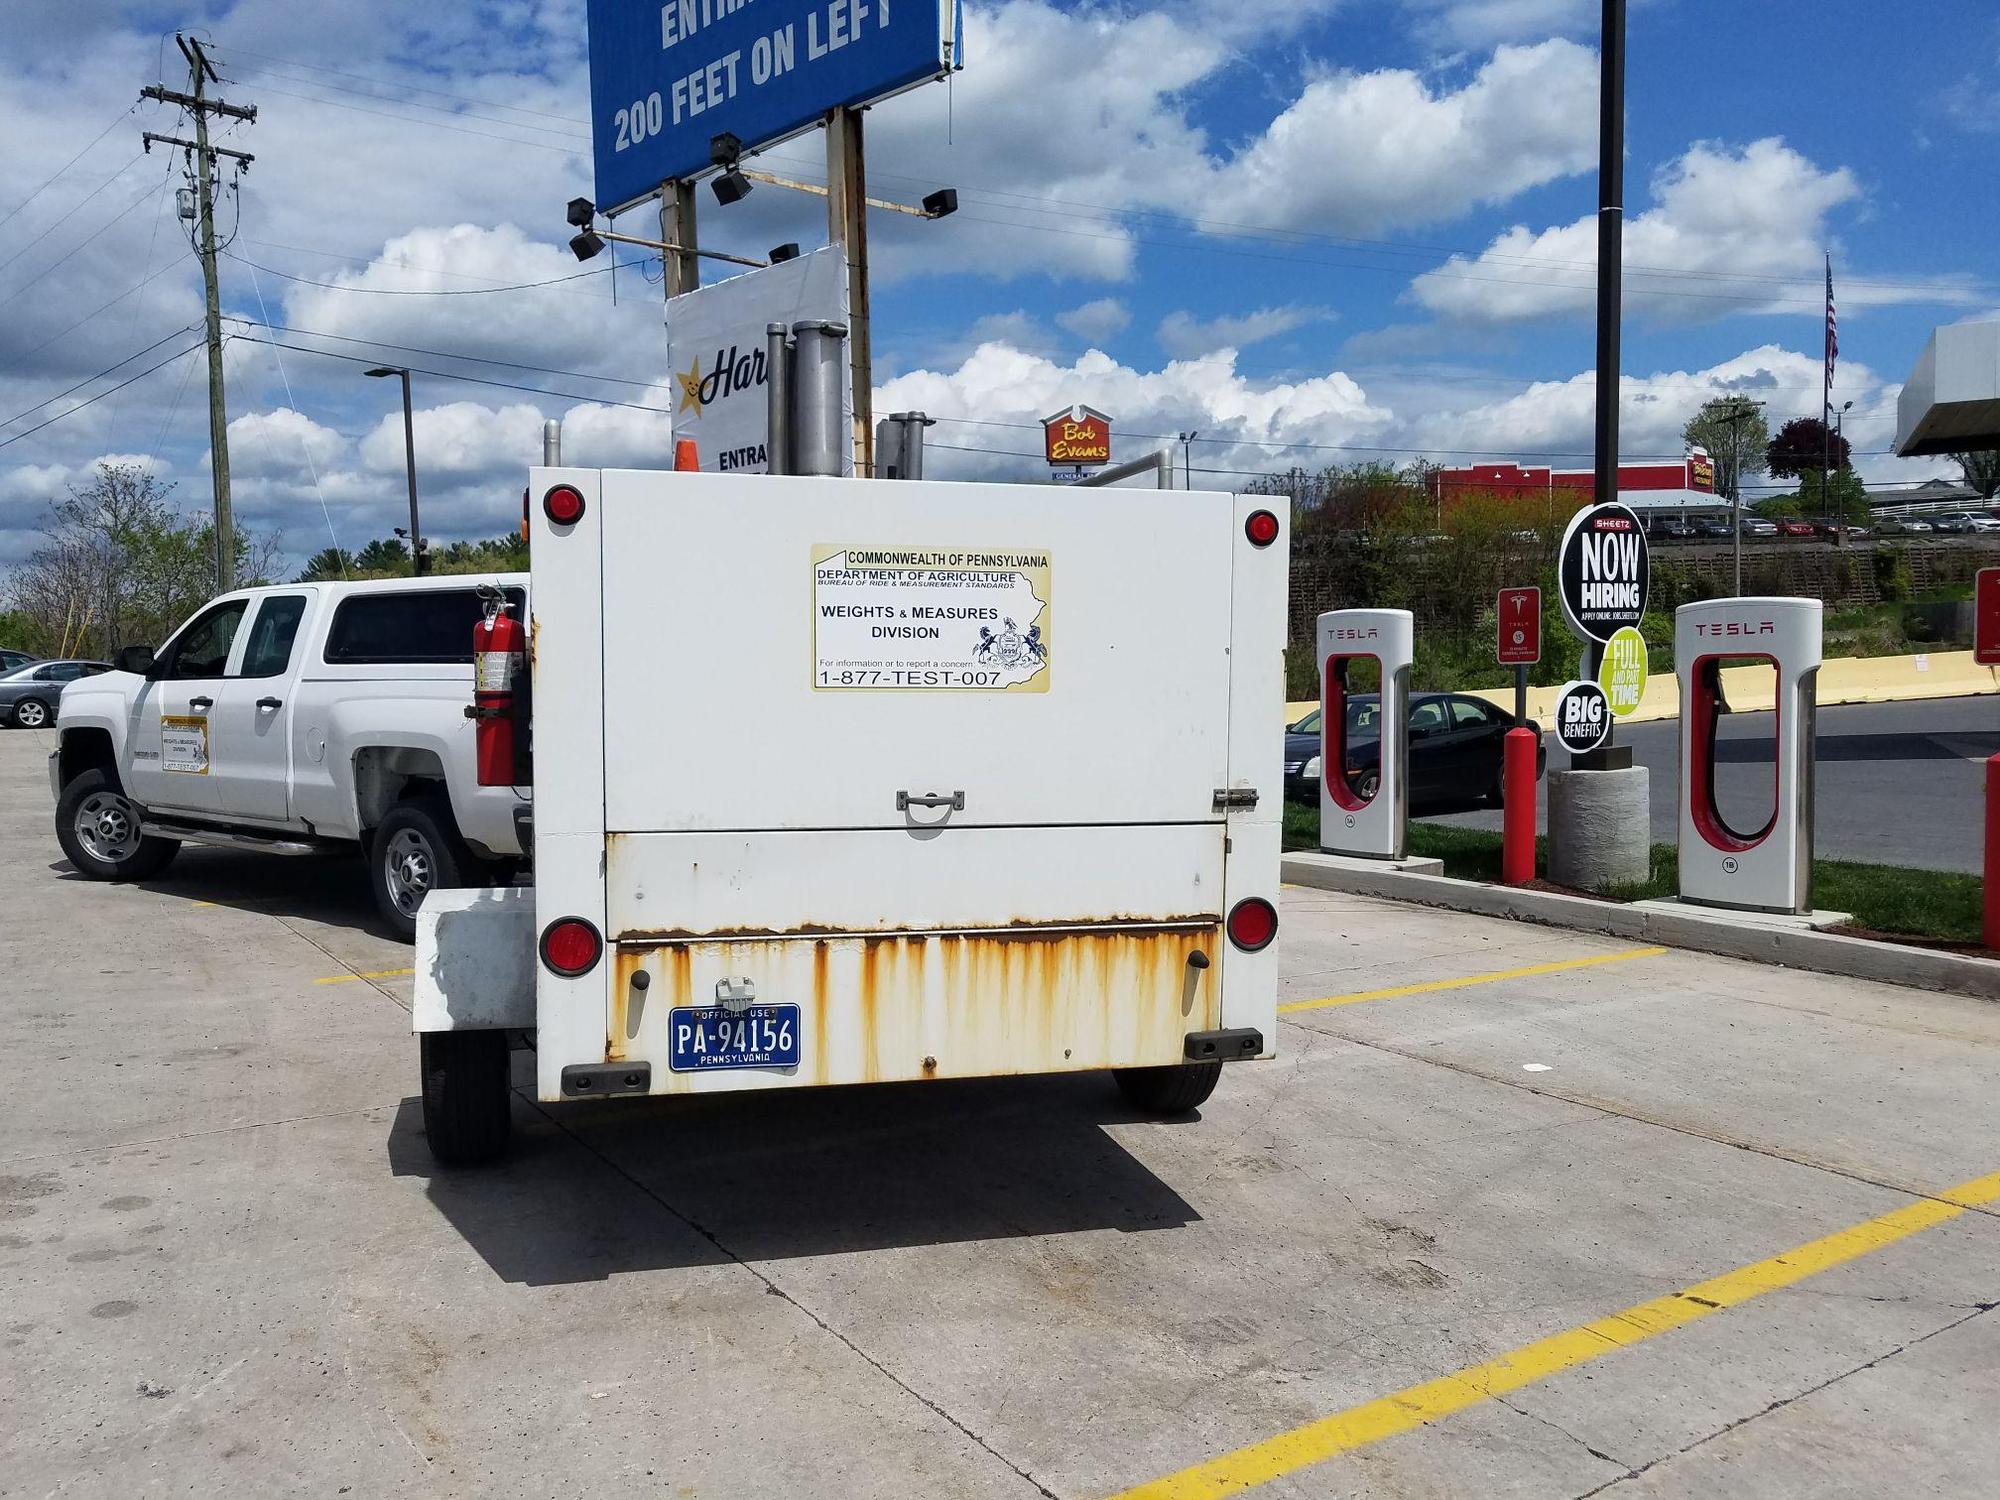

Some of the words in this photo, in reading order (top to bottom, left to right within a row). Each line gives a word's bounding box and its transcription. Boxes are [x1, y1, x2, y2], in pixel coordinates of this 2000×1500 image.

[614, 91, 663, 153] 200
[672, 50, 741, 125] FEET
[751, 23, 795, 86] ON
[807, 0, 890, 61] LEFT
[698, 345, 768, 406] Har
[1062, 422, 1096, 441] Bob
[719, 443, 768, 471] ENTRA
[1051, 440, 1107, 459] Evans
[1596, 519, 1630, 528] SHEETZ
[848, 551, 946, 566] COMMONWEALTH
[948, 553, 964, 566] OF
[966, 554, 1048, 568] PENNSYLVANIA
[1581, 532, 1640, 581] NOW
[817, 569, 904, 580] DEPARTMENT
[907, 571, 925, 581] OF
[927, 571, 1016, 583] AGRICULTURE
[965, 581, 1015, 589] STANDARDS
[1581, 582, 1640, 609] HIRING
[821, 605, 895, 618] WEIGHTS
[899, 609, 907, 618] &
[911, 606, 998, 620] MEASURES
[1581, 611, 1596, 621] APPLY
[871, 626, 940, 639] DIVISION
[1327, 629, 1378, 639] TESLA
[1695, 621, 1775, 636] TESLA
[1613, 639, 1640, 670] FULL
[819, 659, 833, 667] For
[835, 659, 883, 668] information
[896, 660, 904, 668] to
[906, 660, 931, 669] report
[819, 670, 1001, 686] 1-877-TEST-007
[1612, 669, 1626, 686] AND
[1611, 684, 1639, 706] TIME
[1565, 695, 1602, 723] BIG
[1564, 722, 1601, 738] BENEFITS
[701, 1010, 745, 1020] OFFICIAL
[750, 1009, 770, 1018] USE
[677, 1019, 793, 1054] PA-94156
[700, 1053, 771, 1065] PENNSYLVANIA
